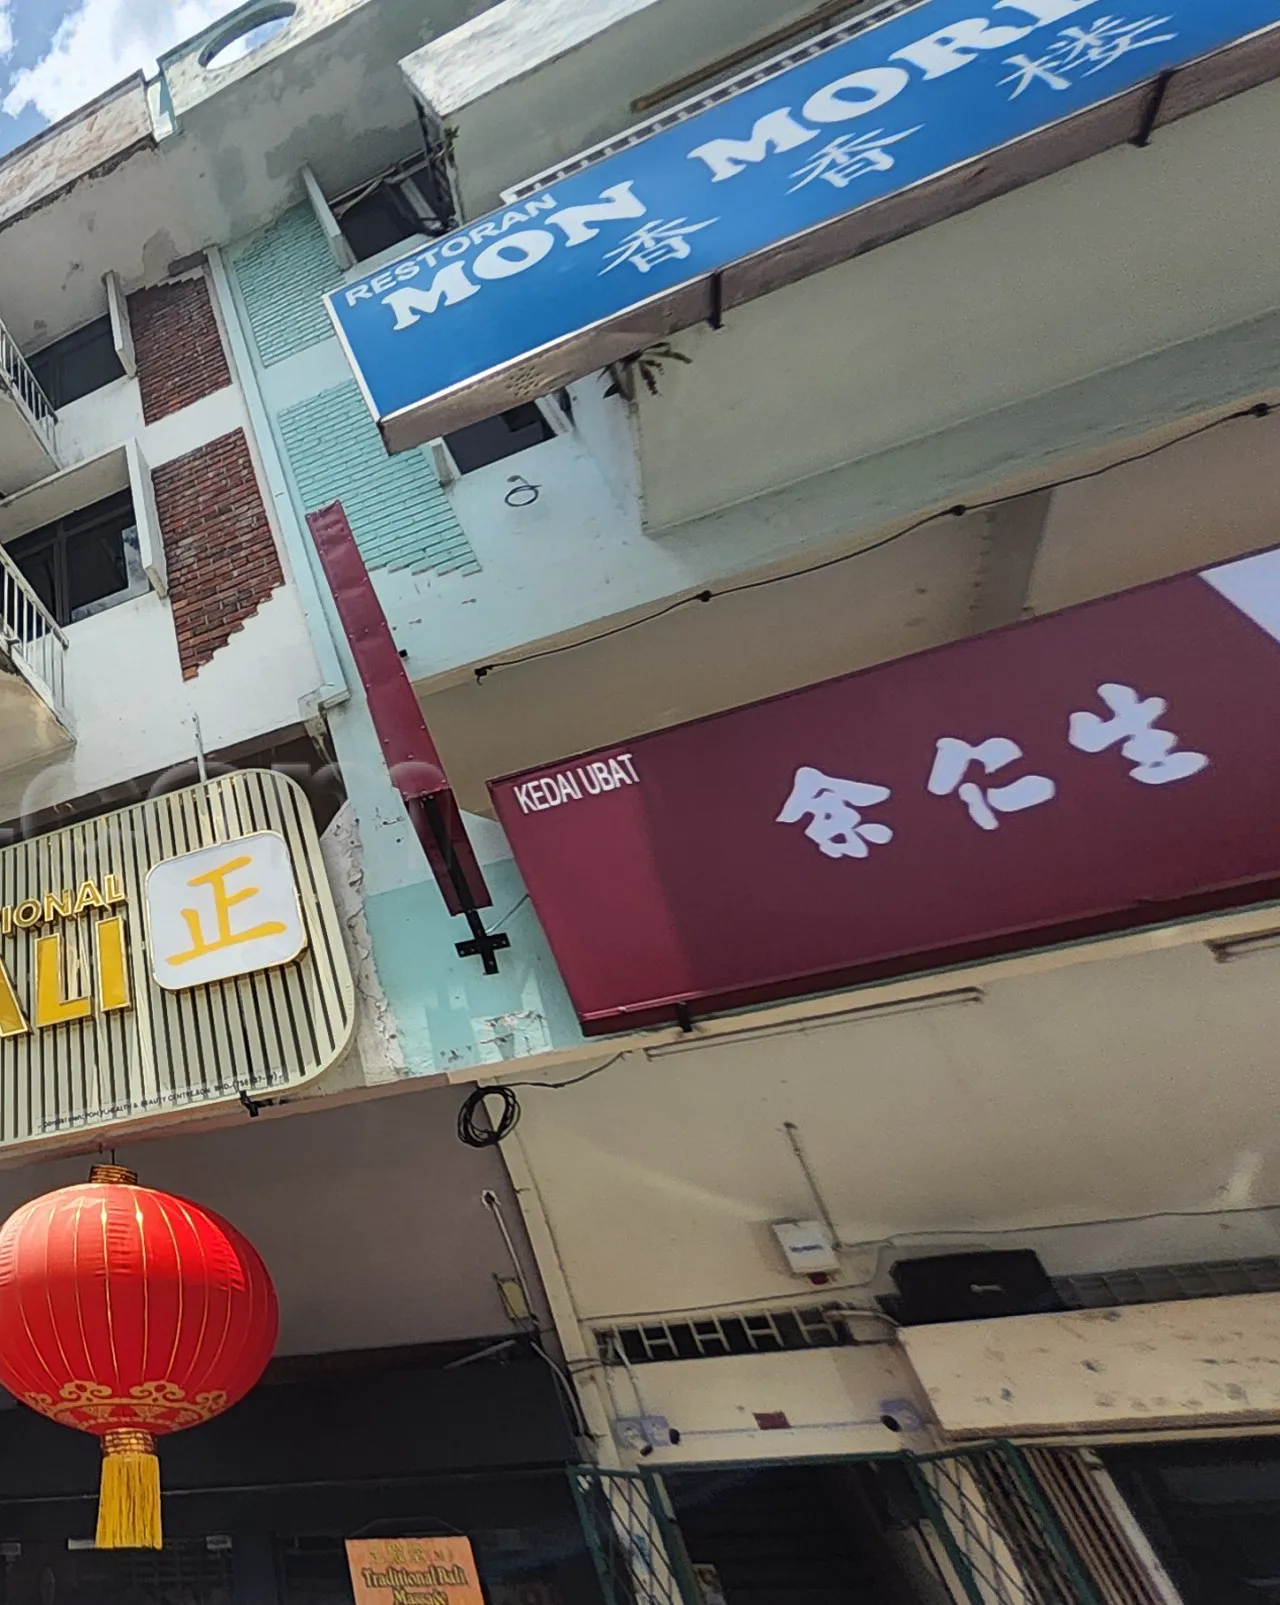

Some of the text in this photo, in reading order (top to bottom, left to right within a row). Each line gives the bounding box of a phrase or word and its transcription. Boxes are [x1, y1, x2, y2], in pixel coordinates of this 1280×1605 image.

[345, 193, 558, 307] RESTORAN
[381, 180, 647, 331] MON
[513, 753, 642, 815] KEDAI UBAT
[776, 682, 1209, 858] 余仁生
[165, 855, 288, 967] 正
[362, 1564, 437, 1588] Traditional
